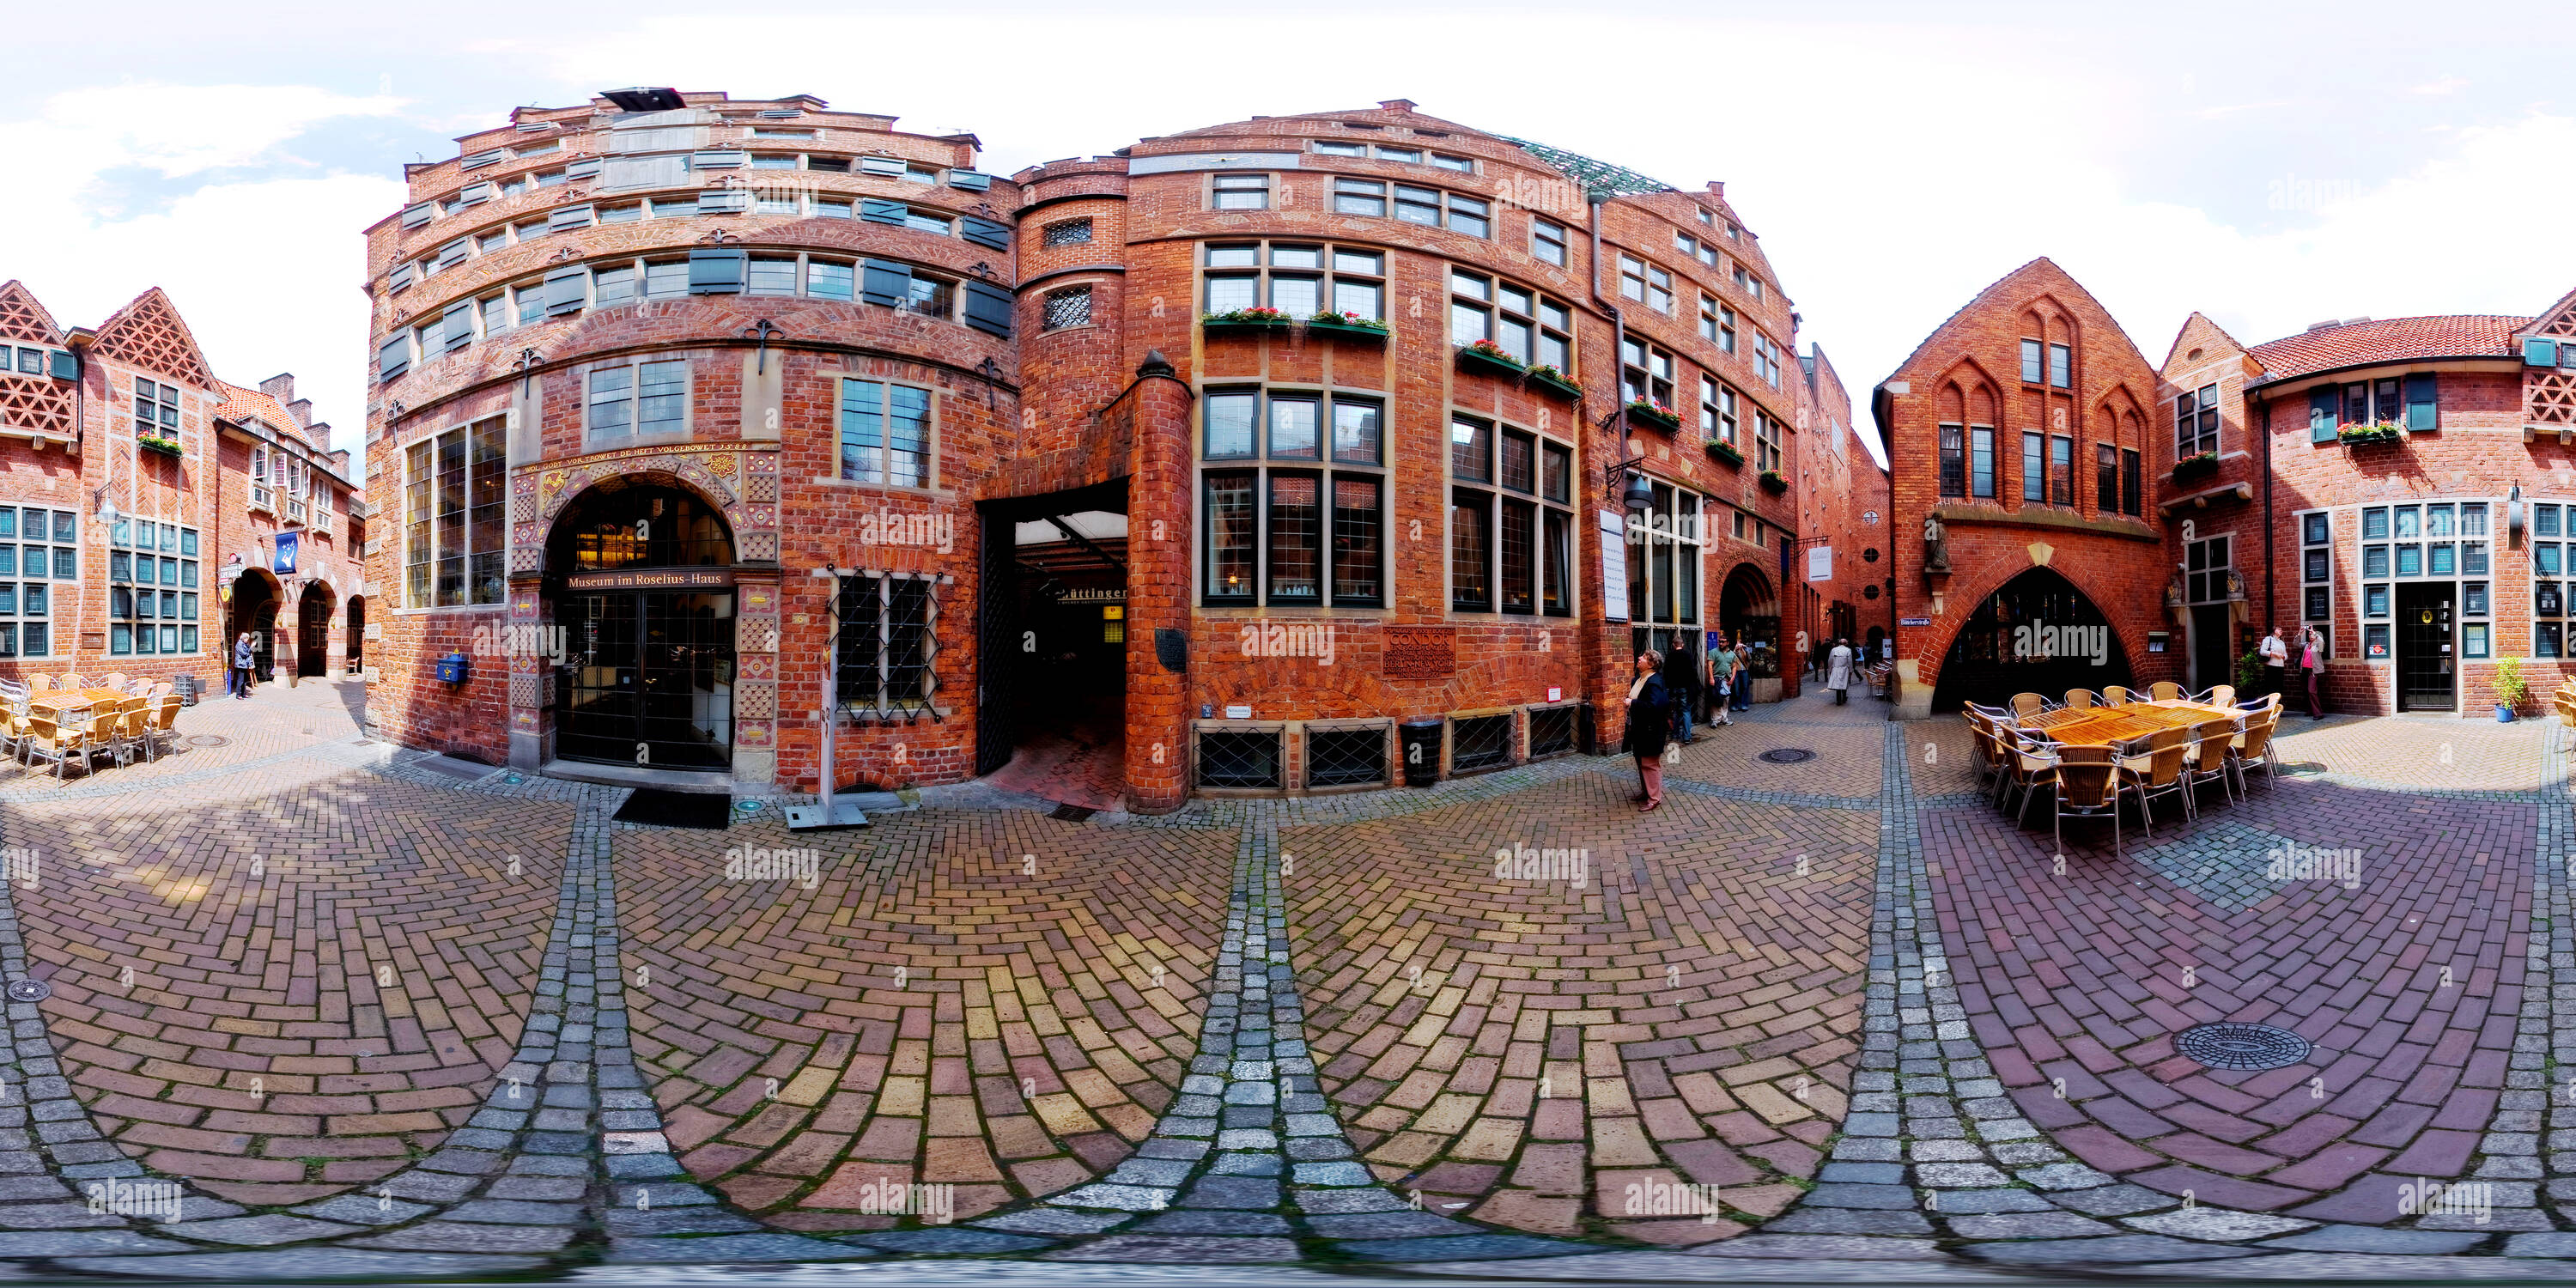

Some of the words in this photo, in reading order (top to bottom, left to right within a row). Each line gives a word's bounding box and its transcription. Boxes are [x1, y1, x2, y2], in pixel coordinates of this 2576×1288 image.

[544, 461, 562, 470] GODT
[567, 457, 583, 465] VOR
[585, 452, 617, 462] TROWET
[634, 447, 654, 456] HEFT
[657, 443, 716, 453] VOLGEBOWET
[568, 577, 614, 588] Museum
[617, 575, 633, 586] im
[636, 573, 722, 585] Roselius-Haus
[1389, 634, 1449, 646] CONDOR
[2219, 1029, 2272, 1039] HYDRANT
